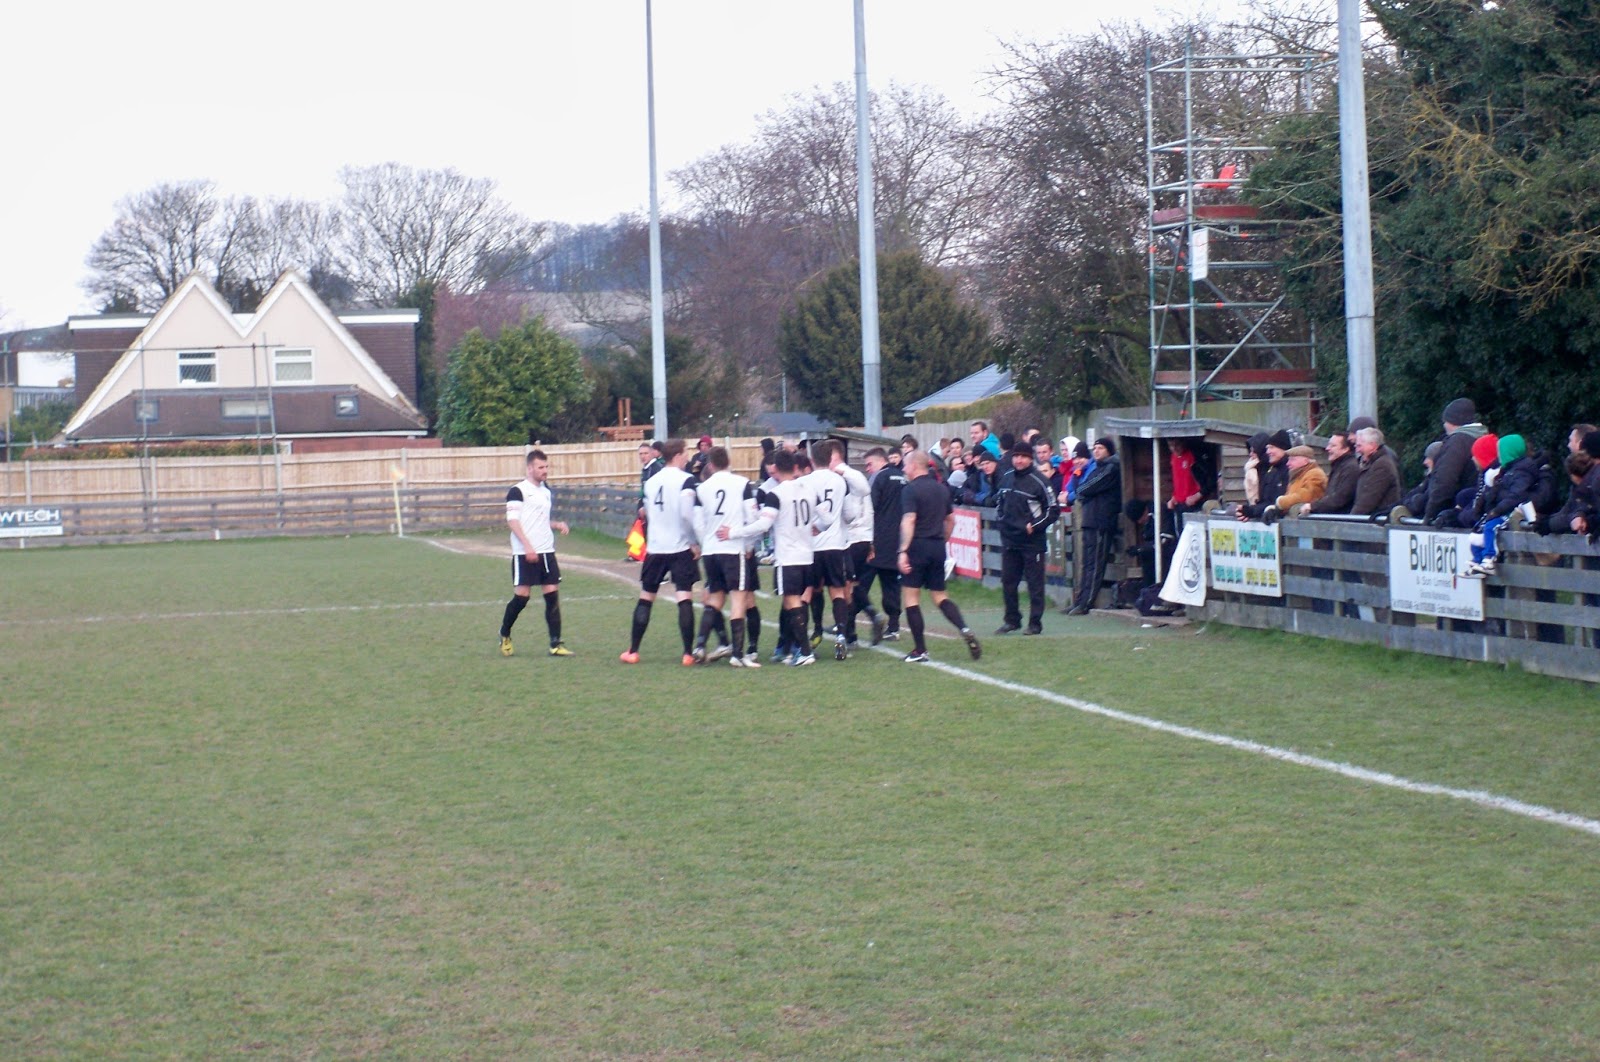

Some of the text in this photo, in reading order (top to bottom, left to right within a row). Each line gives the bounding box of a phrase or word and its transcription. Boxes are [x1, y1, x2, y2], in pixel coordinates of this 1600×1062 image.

[654, 485, 664, 512] 4
[714, 489, 726, 516] 2
[824, 488, 833, 513] 5
[792, 498, 810, 527] 10
[1409, 533, 1458, 575] Bullard
